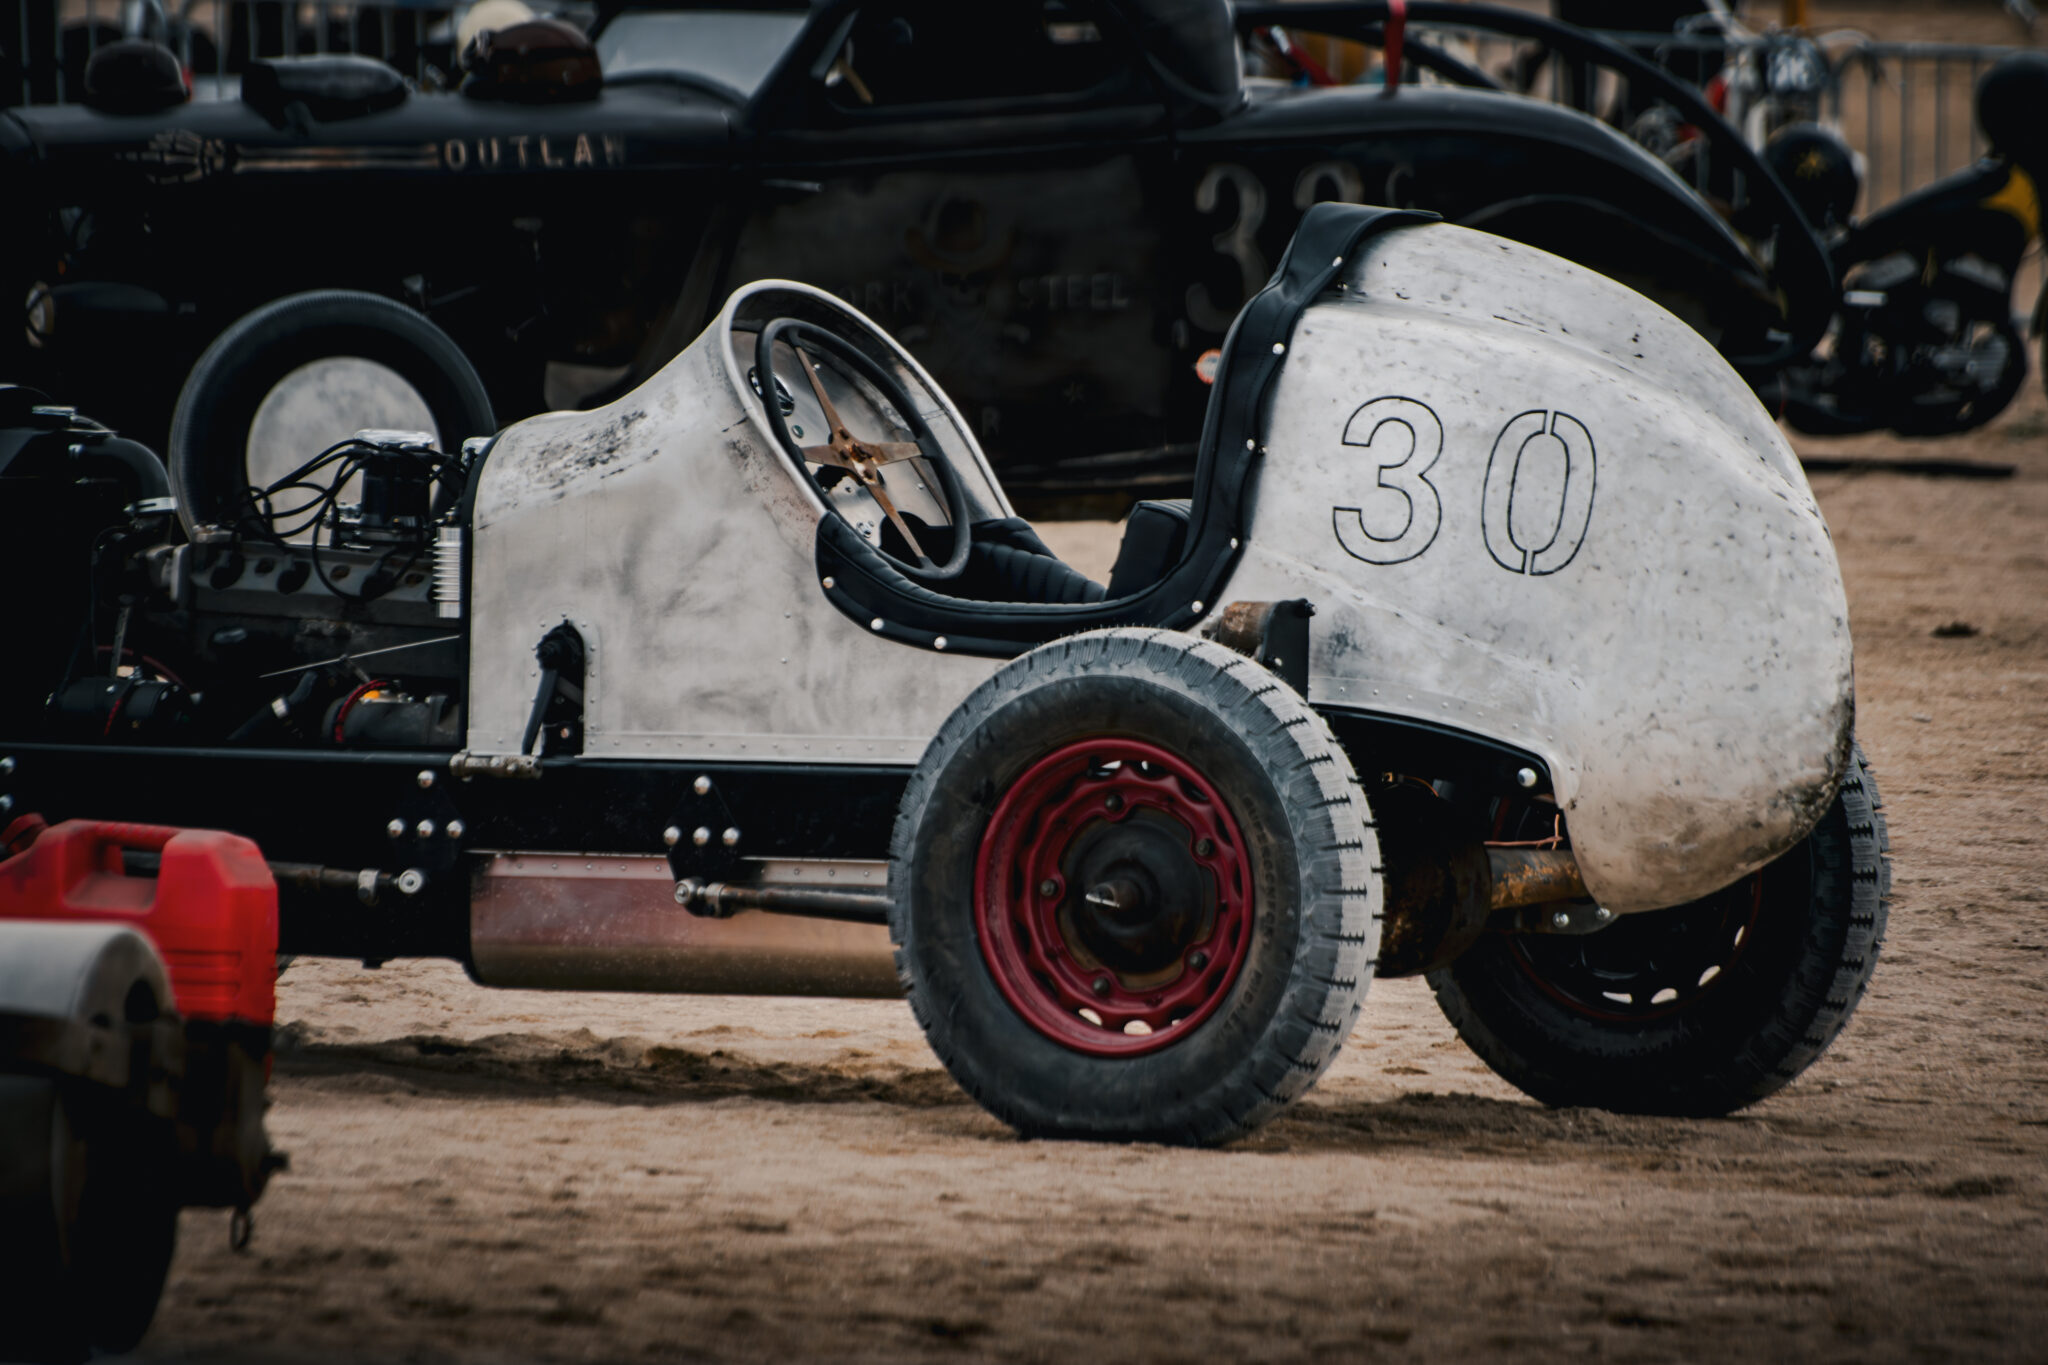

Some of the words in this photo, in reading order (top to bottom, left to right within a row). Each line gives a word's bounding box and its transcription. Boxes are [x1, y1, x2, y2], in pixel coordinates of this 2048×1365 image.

[444, 133, 626, 172] OUTLAW
[1017, 273, 1129, 311] STEEL
[1332, 395, 1597, 577] 30
